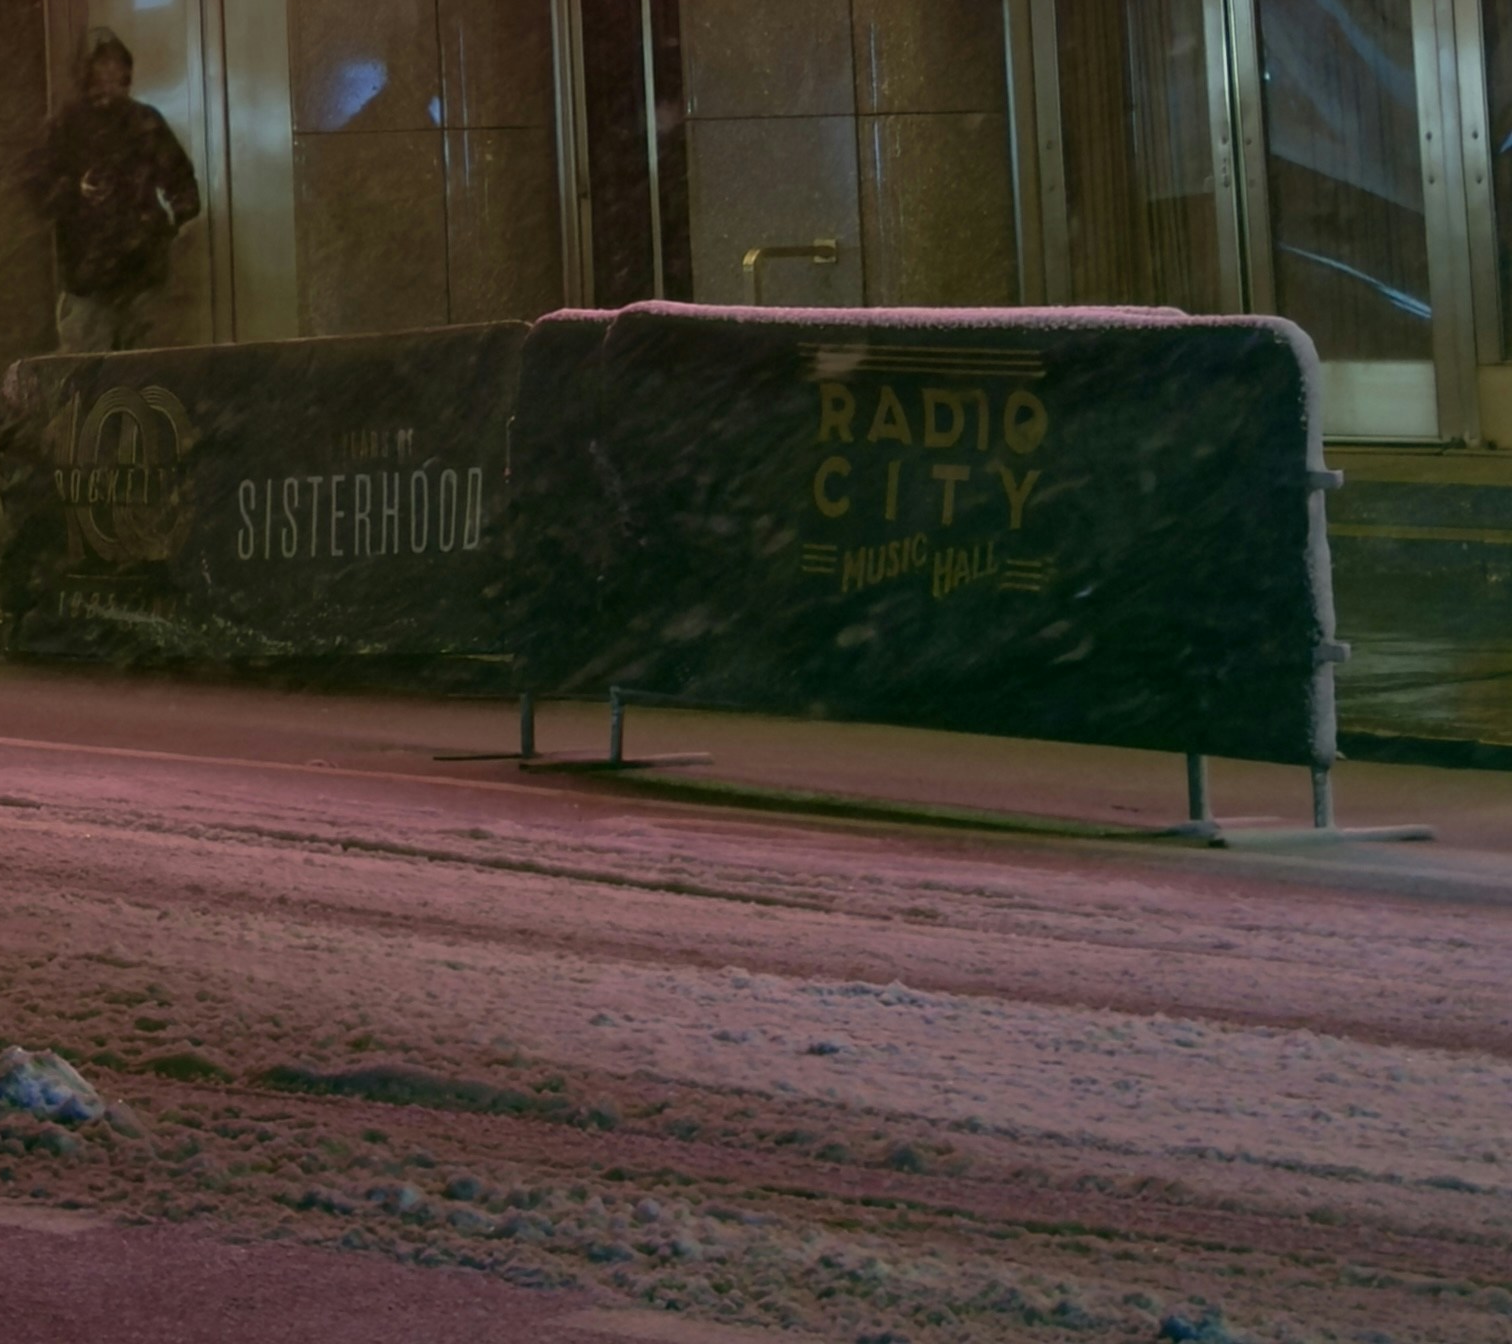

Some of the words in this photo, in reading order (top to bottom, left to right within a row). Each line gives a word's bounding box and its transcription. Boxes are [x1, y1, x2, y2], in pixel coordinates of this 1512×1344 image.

[816, 381, 1050, 455] RADIO
[236, 466, 485, 561] SISTERHOOD
[812, 455, 1044, 530] CITY
[840, 530, 929, 593] MUSIC
[930, 539, 1000, 600] HALL
